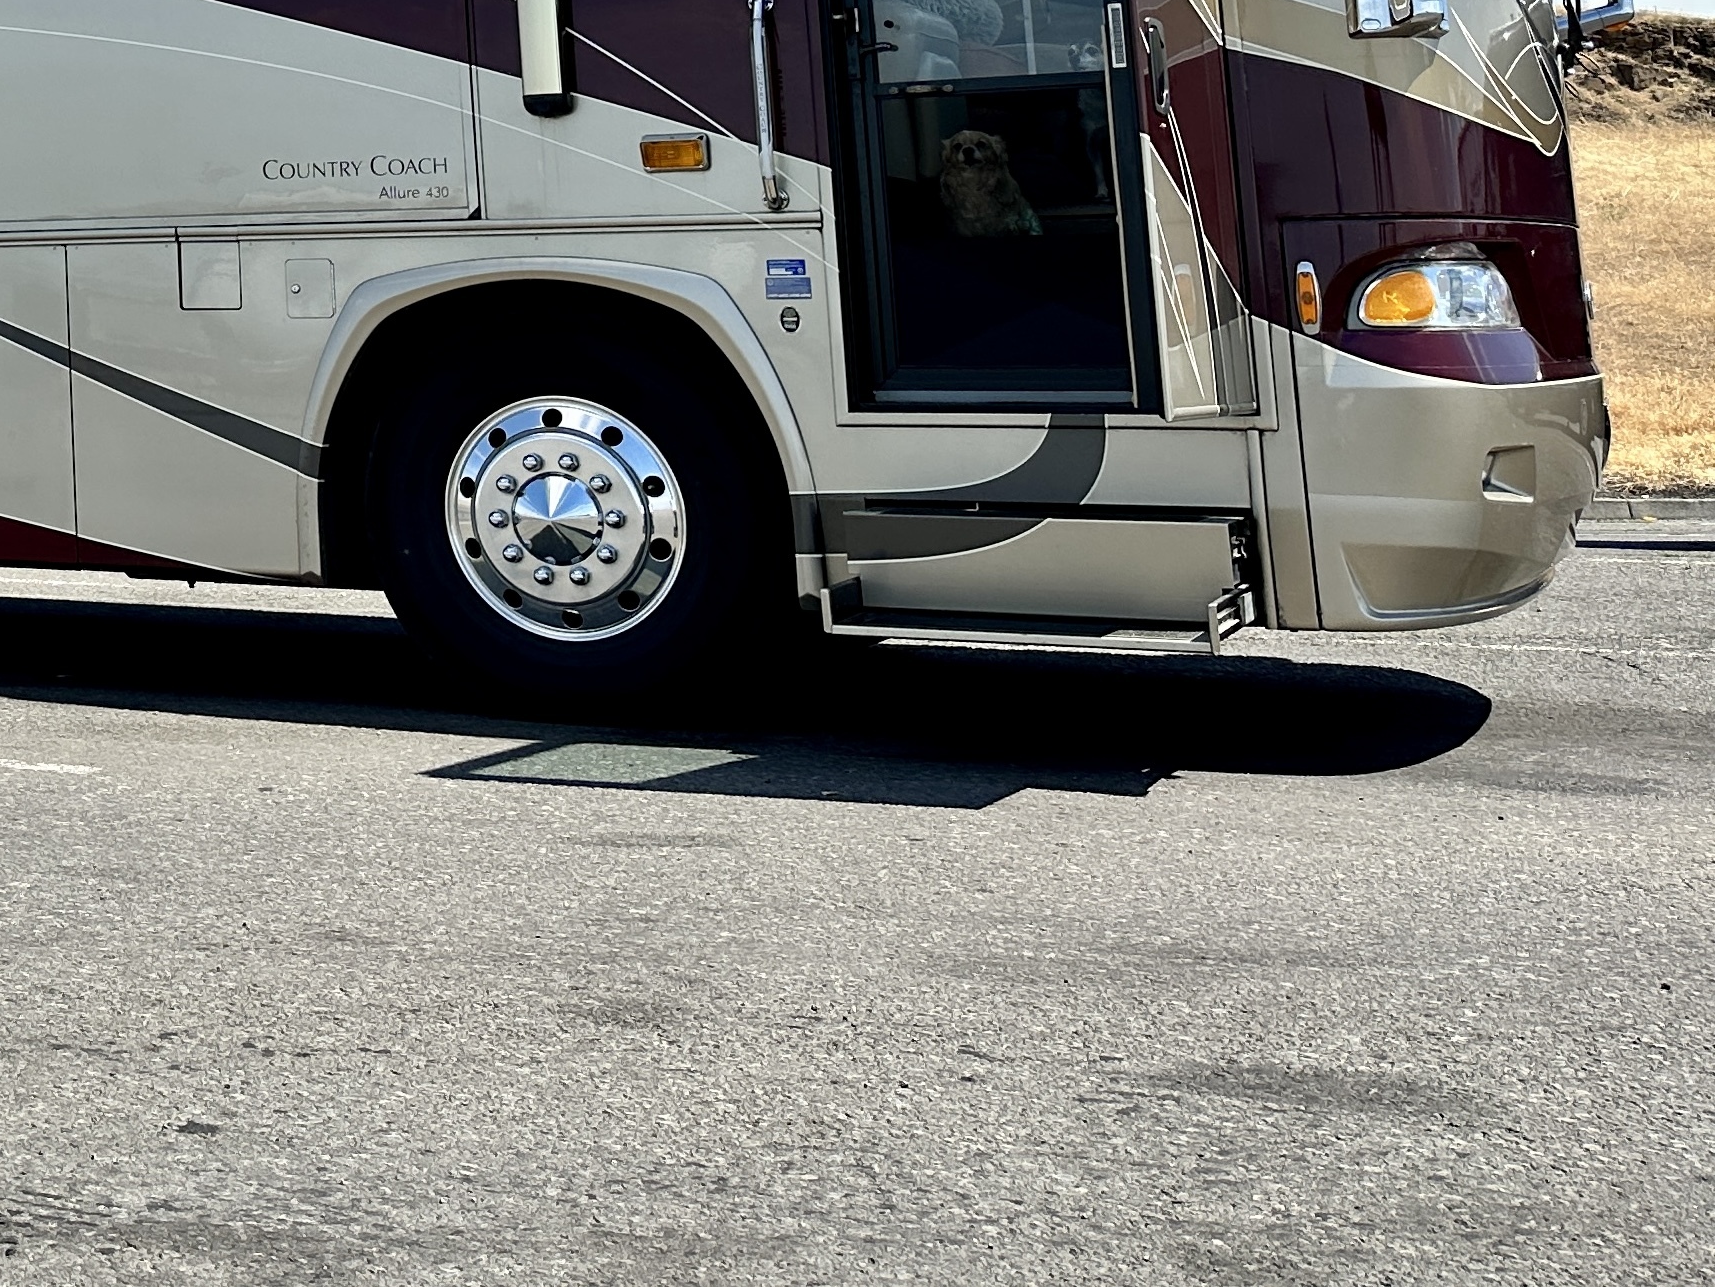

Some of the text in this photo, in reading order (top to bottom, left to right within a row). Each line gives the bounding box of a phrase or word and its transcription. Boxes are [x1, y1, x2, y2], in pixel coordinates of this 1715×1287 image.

[262, 155, 448, 180] COUNTRY COACH
[378, 186, 449, 199] Allure 430
